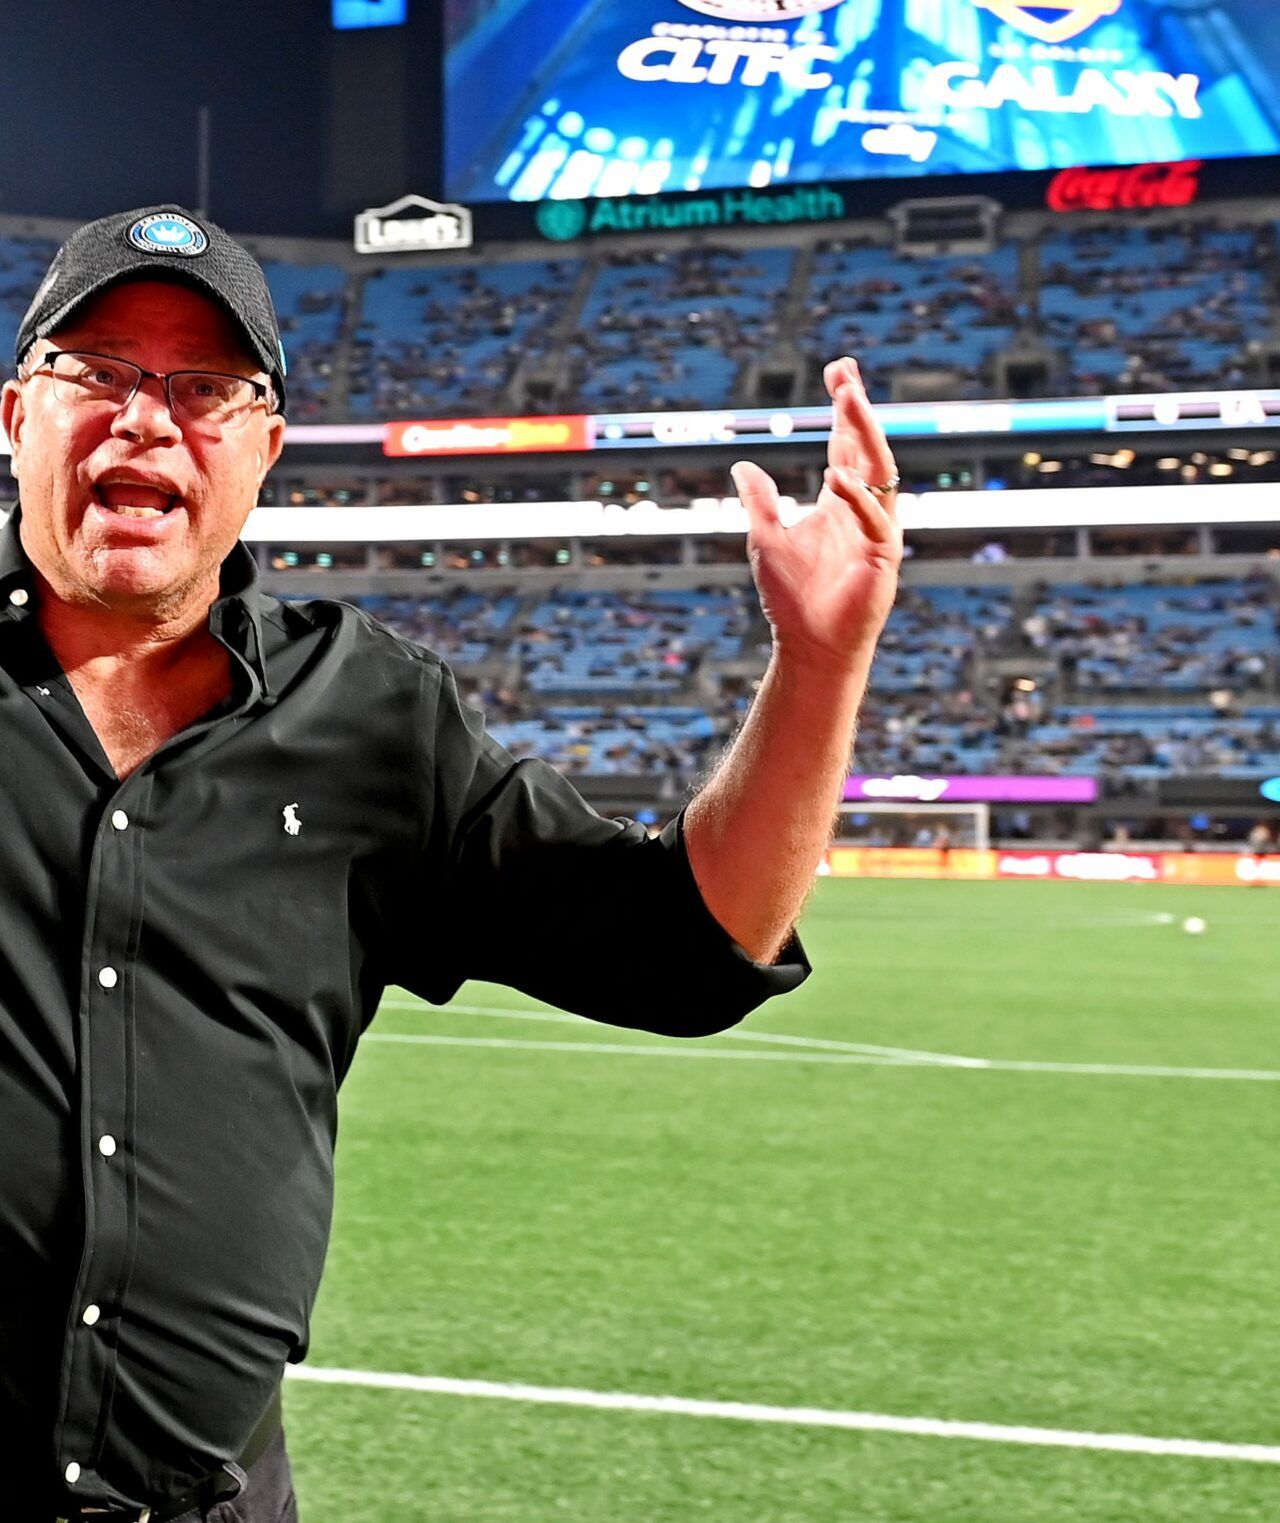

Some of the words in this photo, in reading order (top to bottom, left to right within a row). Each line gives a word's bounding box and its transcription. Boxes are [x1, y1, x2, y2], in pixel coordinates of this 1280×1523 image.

[617, 36, 839, 89] CLTFC
[928, 61, 1202, 119] GALAXY
[590, 198, 720, 231] Atrium
[723, 187, 844, 224] Health
